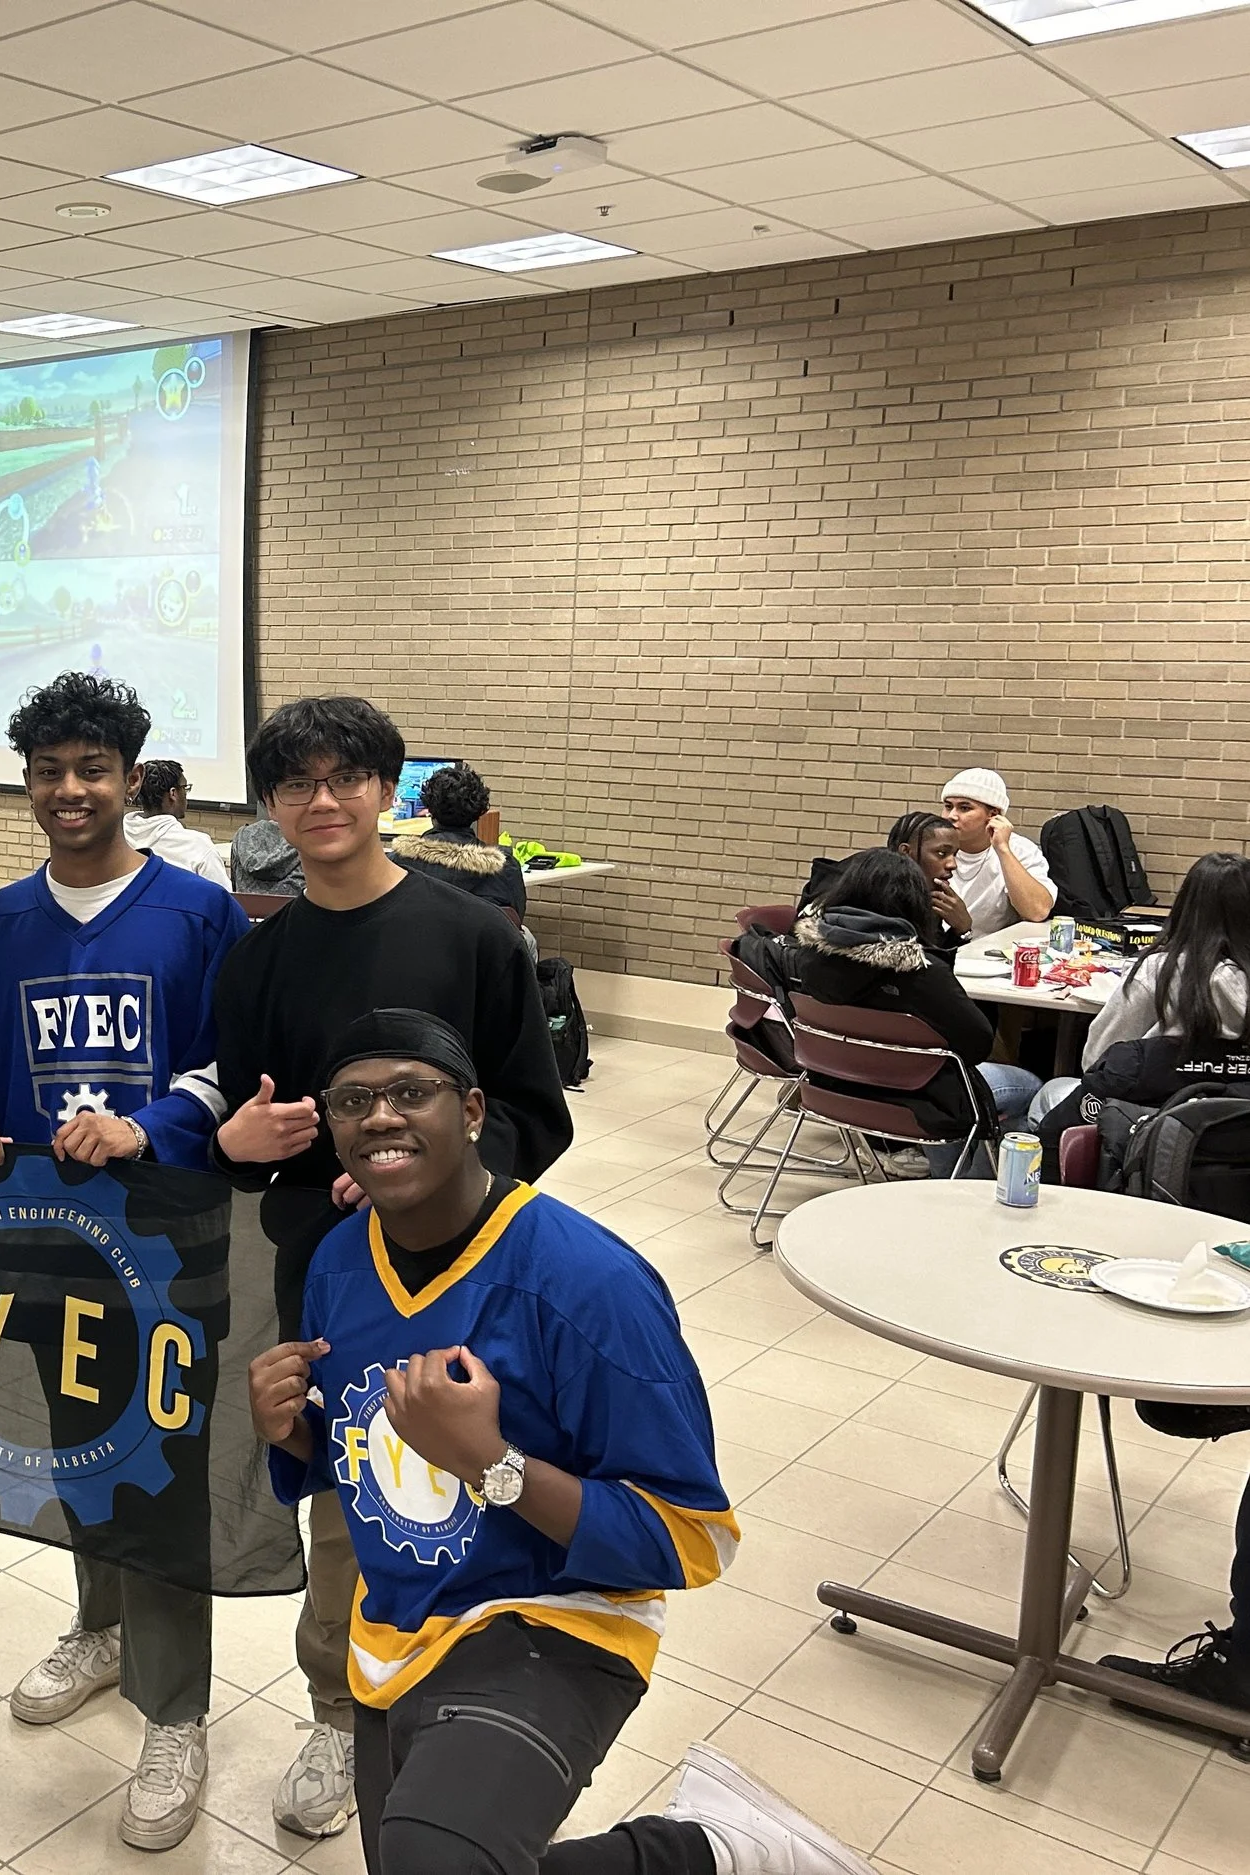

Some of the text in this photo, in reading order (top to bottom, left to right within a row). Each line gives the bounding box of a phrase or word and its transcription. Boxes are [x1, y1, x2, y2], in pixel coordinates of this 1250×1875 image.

[30, 993, 142, 1052] FYEC
[8, 1206, 110, 1246] ENGINEERING
[111, 1246, 141, 1289] CLUB
[363, 1400, 378, 1420] FIRST
[24, 1455, 42, 1468] OF
[52, 1440, 116, 1469] ALBERTA
